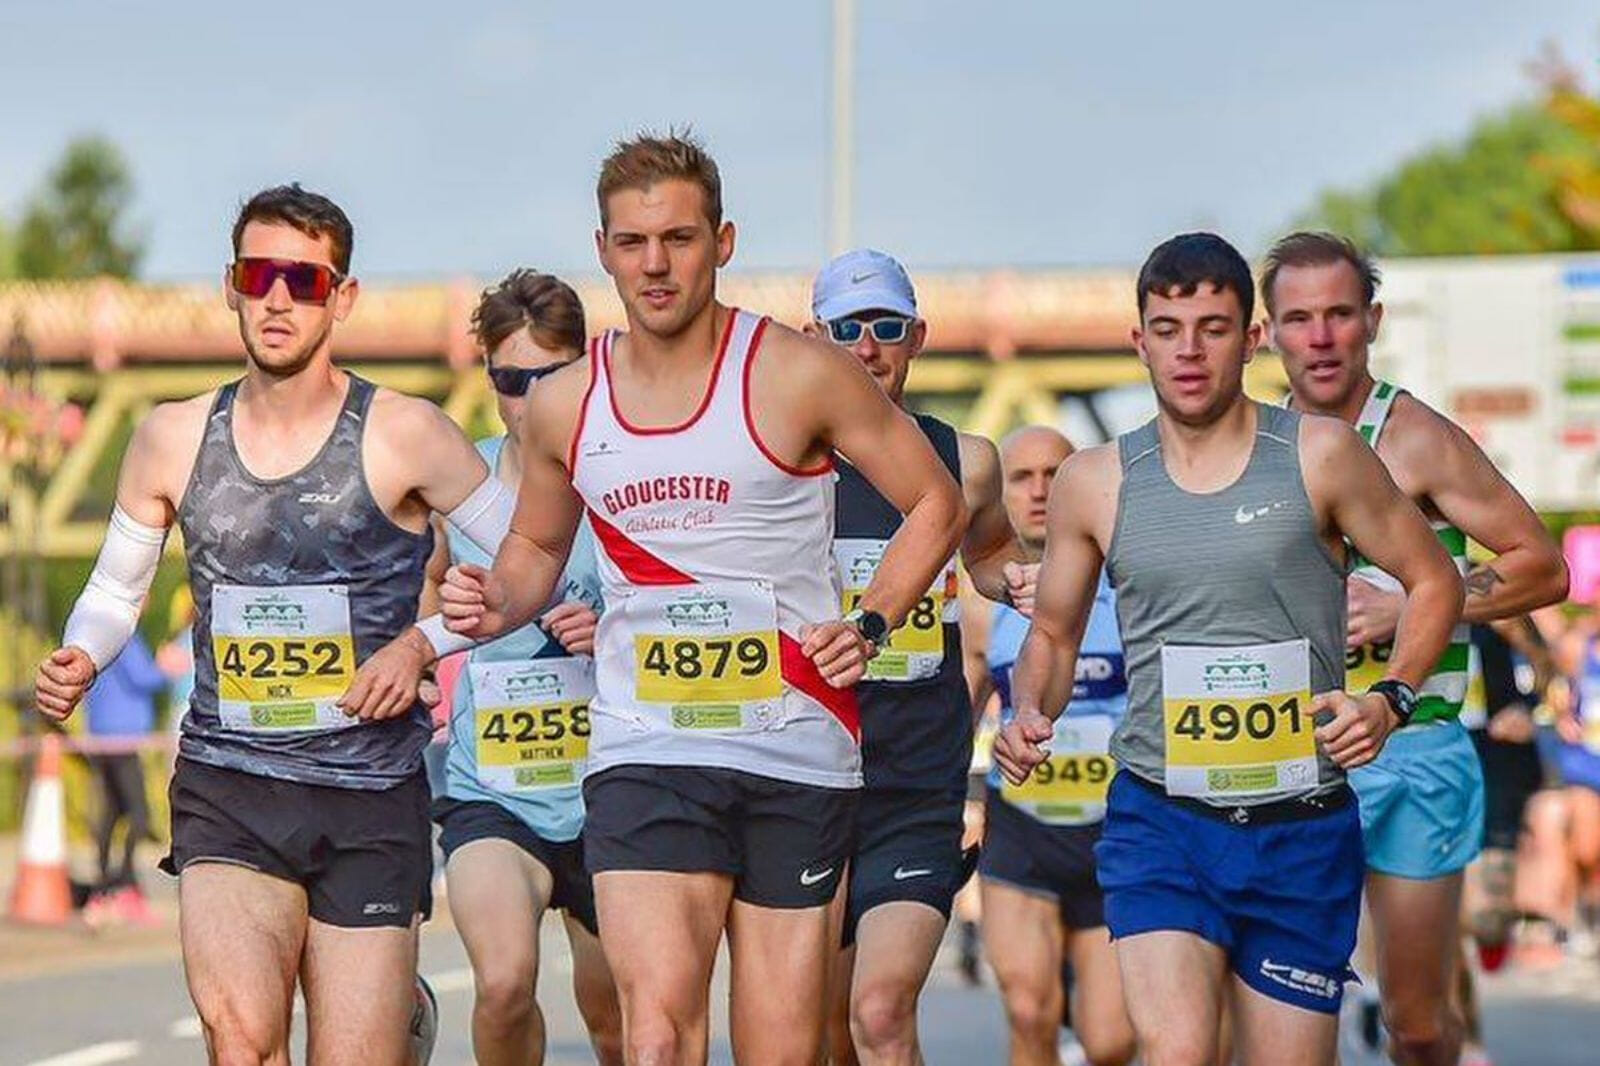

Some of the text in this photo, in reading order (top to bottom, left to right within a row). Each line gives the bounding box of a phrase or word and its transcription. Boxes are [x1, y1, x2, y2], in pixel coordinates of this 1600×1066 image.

[602, 475, 731, 516] GLOUCESTER
[222, 641, 343, 678] 4252
[644, 638, 768, 679] 4879
[266, 684, 292, 698] NICK
[482, 705, 591, 744] 4258
[1174, 697, 1301, 741] 4901
[1034, 758, 1109, 785] 949
